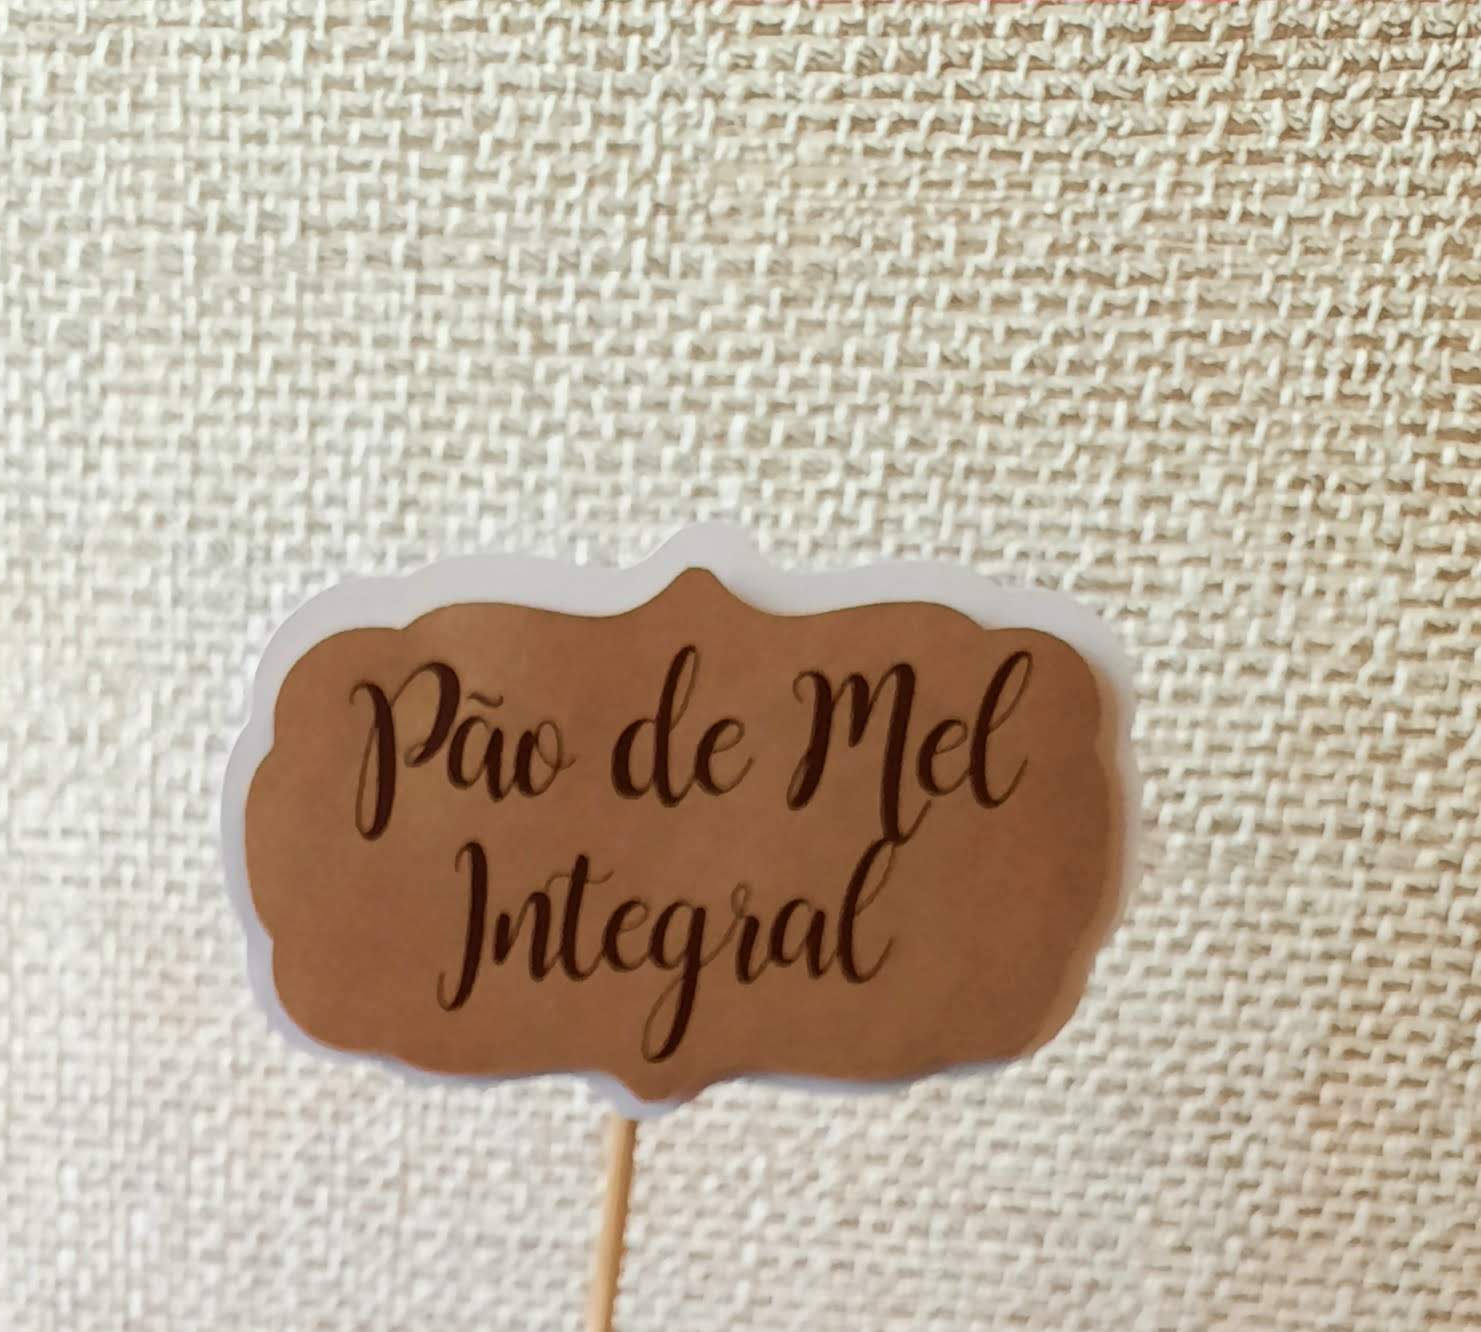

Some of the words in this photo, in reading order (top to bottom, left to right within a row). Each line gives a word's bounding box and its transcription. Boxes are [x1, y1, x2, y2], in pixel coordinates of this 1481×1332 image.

[349, 660, 576, 842] Pão
[611, 644, 756, 808] de
[786, 650, 1033, 847] Mel
[437, 838, 895, 1065] Integral
